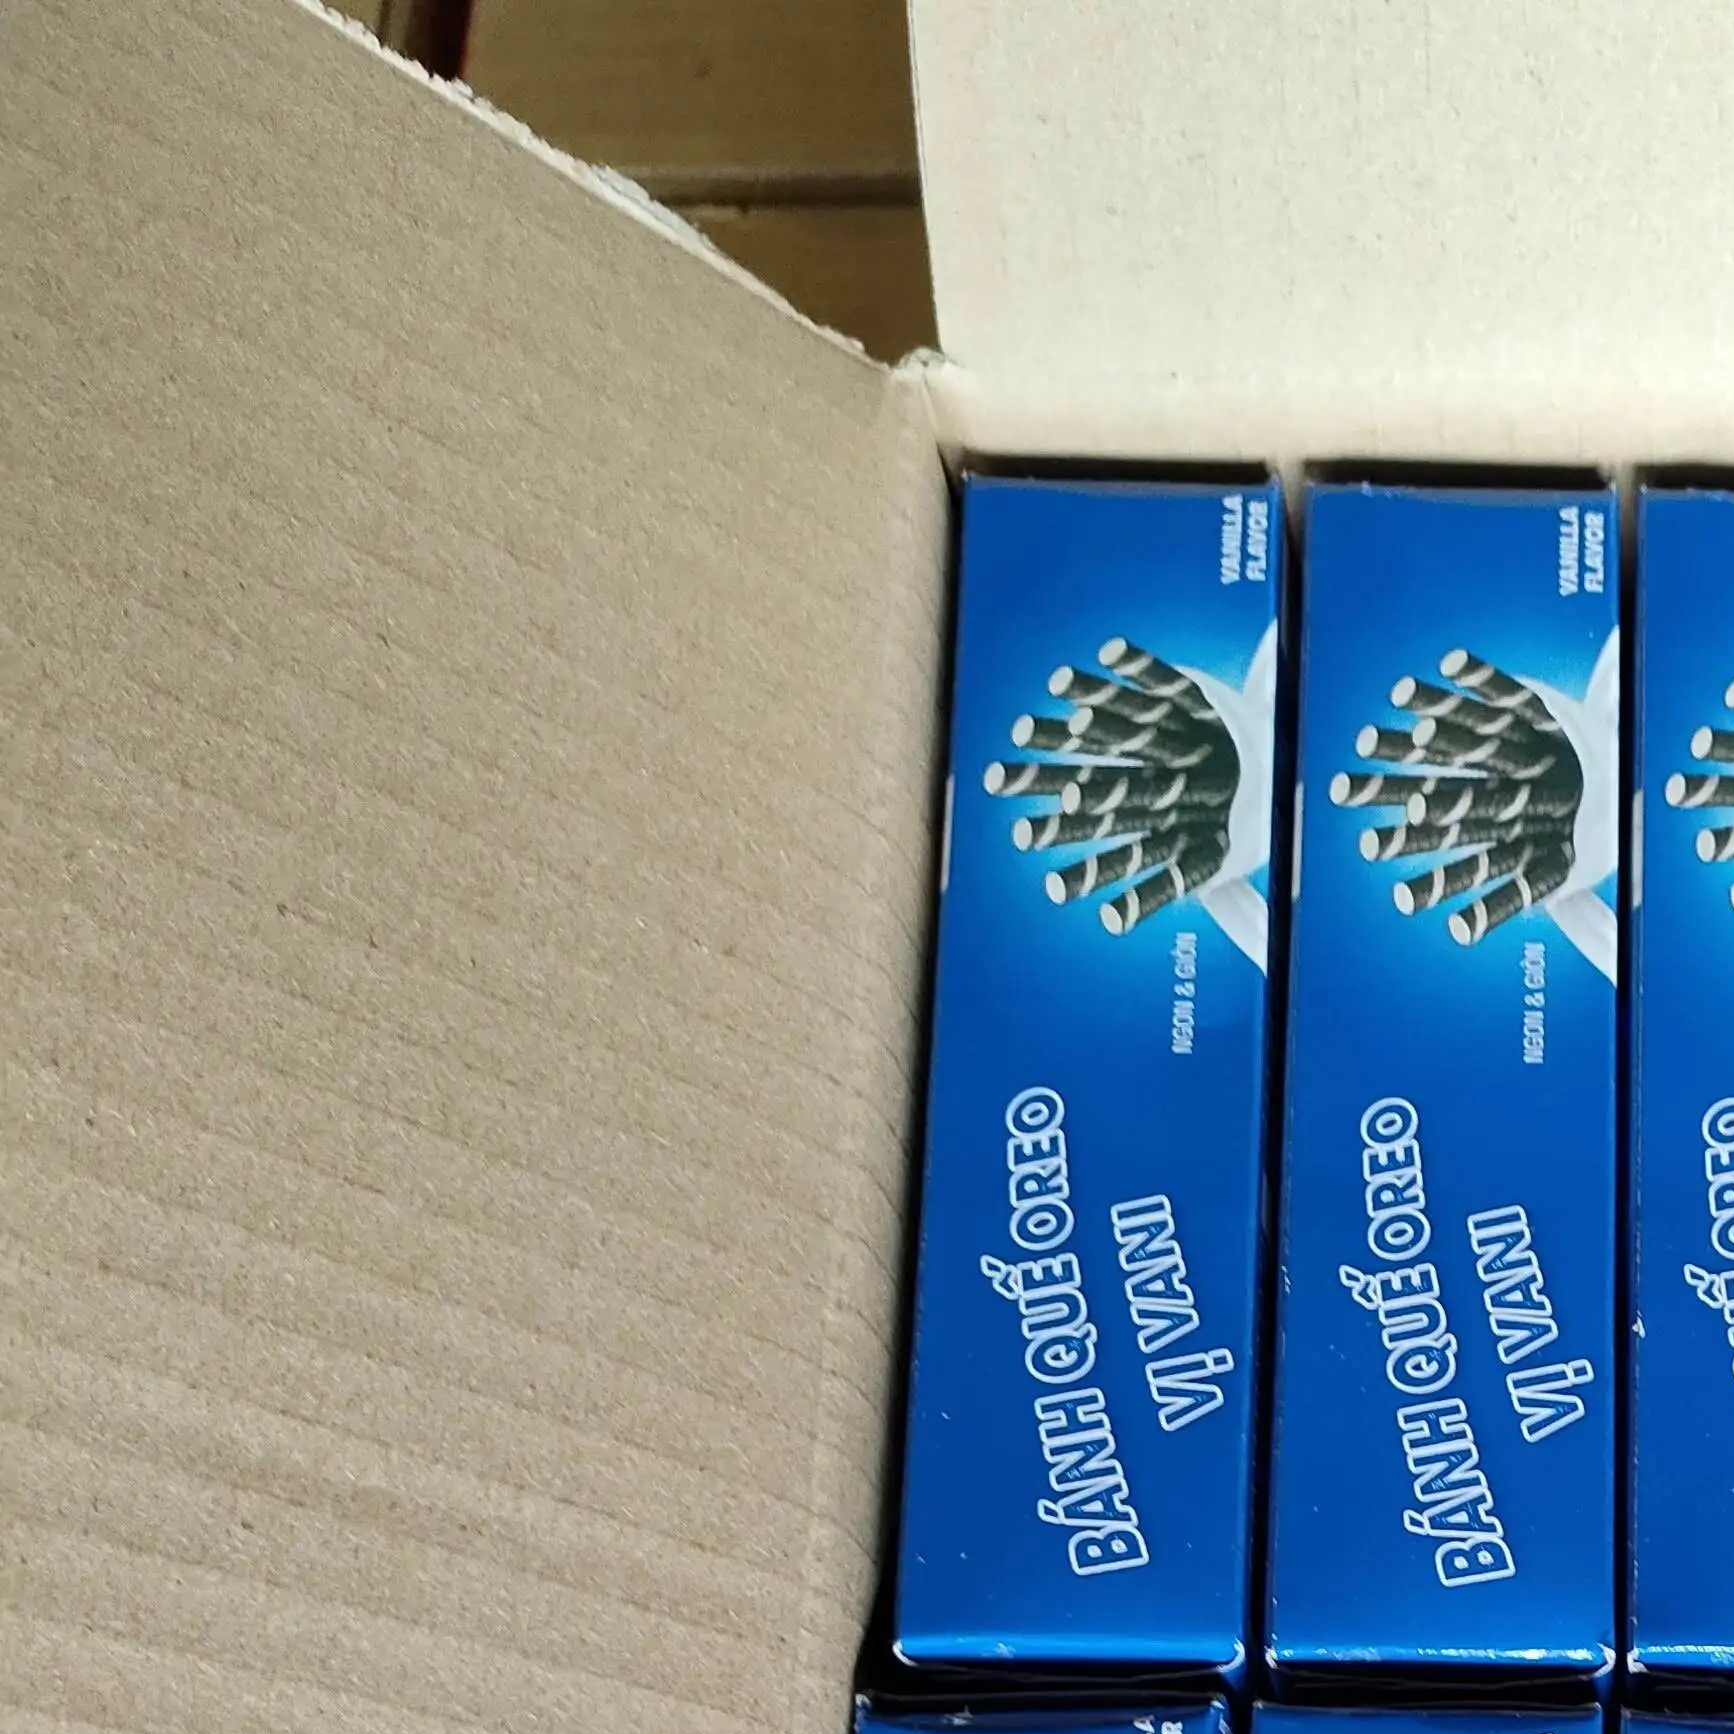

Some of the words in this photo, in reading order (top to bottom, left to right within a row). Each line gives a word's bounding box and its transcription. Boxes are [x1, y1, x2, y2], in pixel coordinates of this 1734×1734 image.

[1220, 494, 1243, 585] VANILLA
[1245, 500, 1268, 582] FLAVOR
[1559, 505, 1580, 597] VANILLA
[1584, 510, 1605, 594] FLAVOR
[1005, 1086, 1075, 1252] OREO
[1360, 1097, 1433, 1262] OREO
[980, 1252, 1099, 1385] QUẾ
[1110, 1194, 1200, 1354] VANI
[1338, 1262, 1458, 1395] QUẾ
[1466, 1204, 1559, 1365] VANI
[1145, 1347, 1235, 1432] VỊ
[1506, 1358, 1595, 1443] VỊ
[1035, 1388, 1149, 1576] BÁNH
[1396, 1398, 1516, 1587] BÁNH
